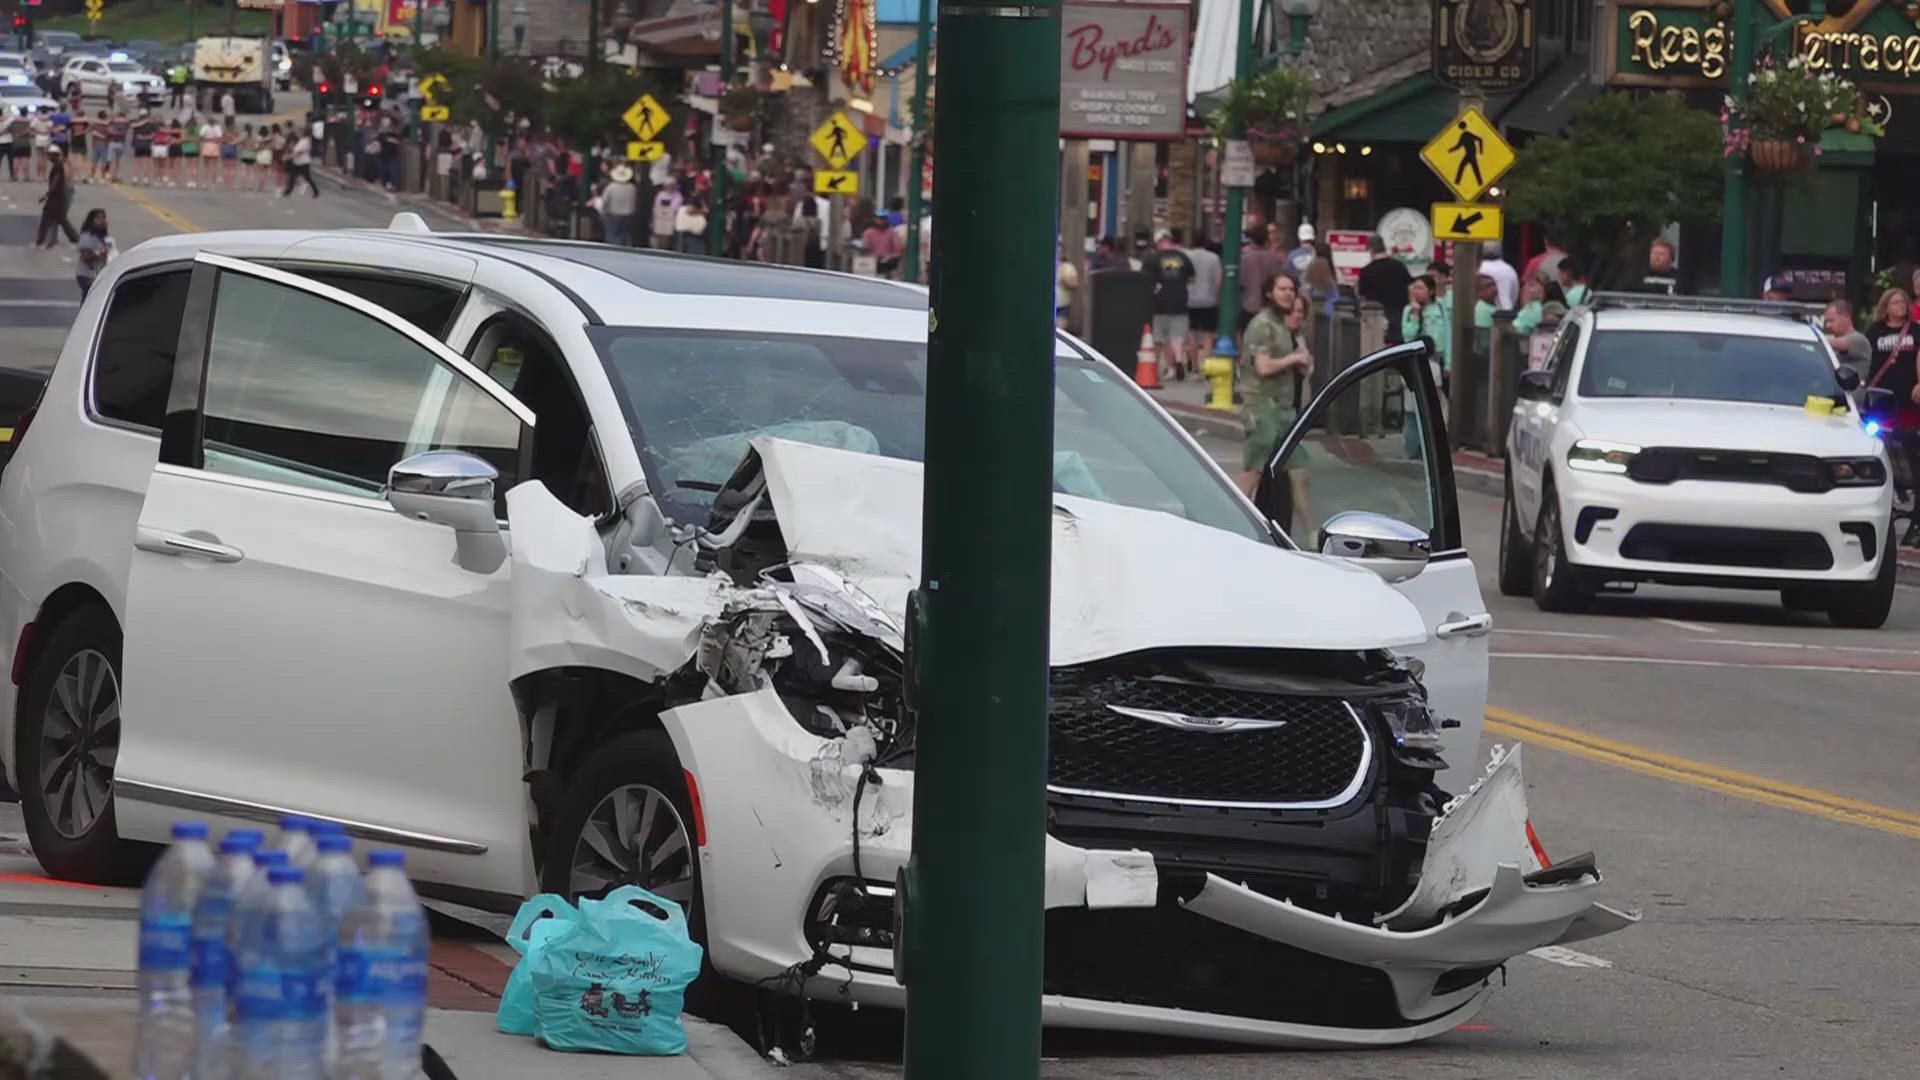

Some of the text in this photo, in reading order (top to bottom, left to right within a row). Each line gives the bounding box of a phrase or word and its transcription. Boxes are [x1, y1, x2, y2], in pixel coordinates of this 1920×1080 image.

[1066, 14, 1177, 82] Byrd's
[1499, 65, 1521, 78] CO
[1629, 10, 1735, 78] Reag
